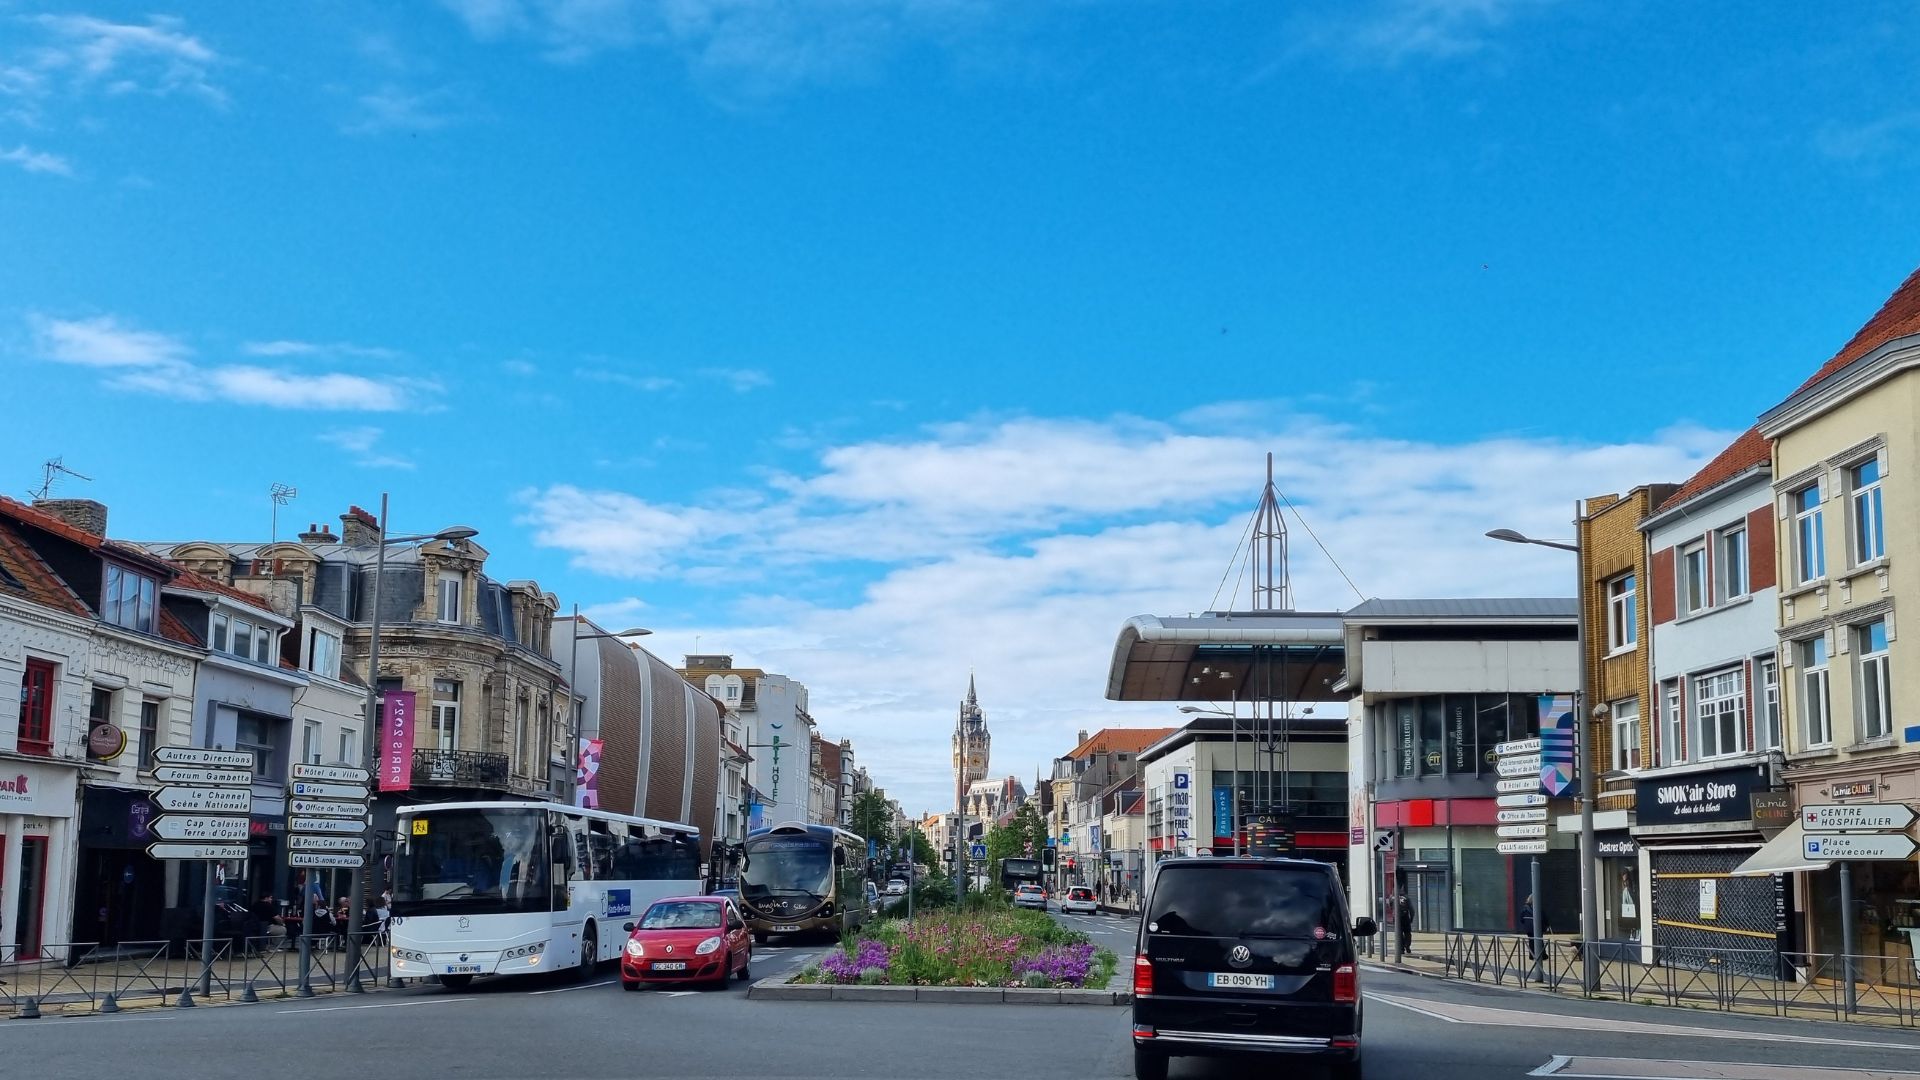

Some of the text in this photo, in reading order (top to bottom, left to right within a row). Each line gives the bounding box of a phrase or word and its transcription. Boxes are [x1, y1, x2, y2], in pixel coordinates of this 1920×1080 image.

[1505, 744, 1524, 752] Centre
[1524, 741, 1540, 749] VILLE
[166, 751, 251, 764] Autres Directions
[171, 771, 250, 782] Forum Gambetta
[304, 768, 325, 777] Hôtel
[342, 771, 359, 779] Ville
[306, 785, 324, 794] Gare
[1657, 782, 1737, 804] SMOK'air Store
[192, 791, 246, 800] Le Channel
[1174, 792, 1189, 806] 1h30
[170, 799, 248, 810] Scène Nationale
[1754, 798, 1788, 808] la mie
[305, 803, 363, 814] Office de Tourisme
[1820, 808, 1863, 817] CENTRE
[186, 819, 204, 829] Cap
[210, 819, 247, 829] Calaisis
[294, 820, 314, 829] Ecole
[318, 821, 336, 830] d'Art
[1174, 819, 1189, 829] FREE
[1821, 817, 1892, 826] HOSPITALIER
[184, 828, 247, 839] Terre d'Opale
[323, 839, 336, 847] Car
[340, 839, 359, 849] Ferry
[1821, 838, 1851, 846] Place
[205, 848, 246, 856] La Poste
[1822, 847, 1885, 856] Crèvecoeur
